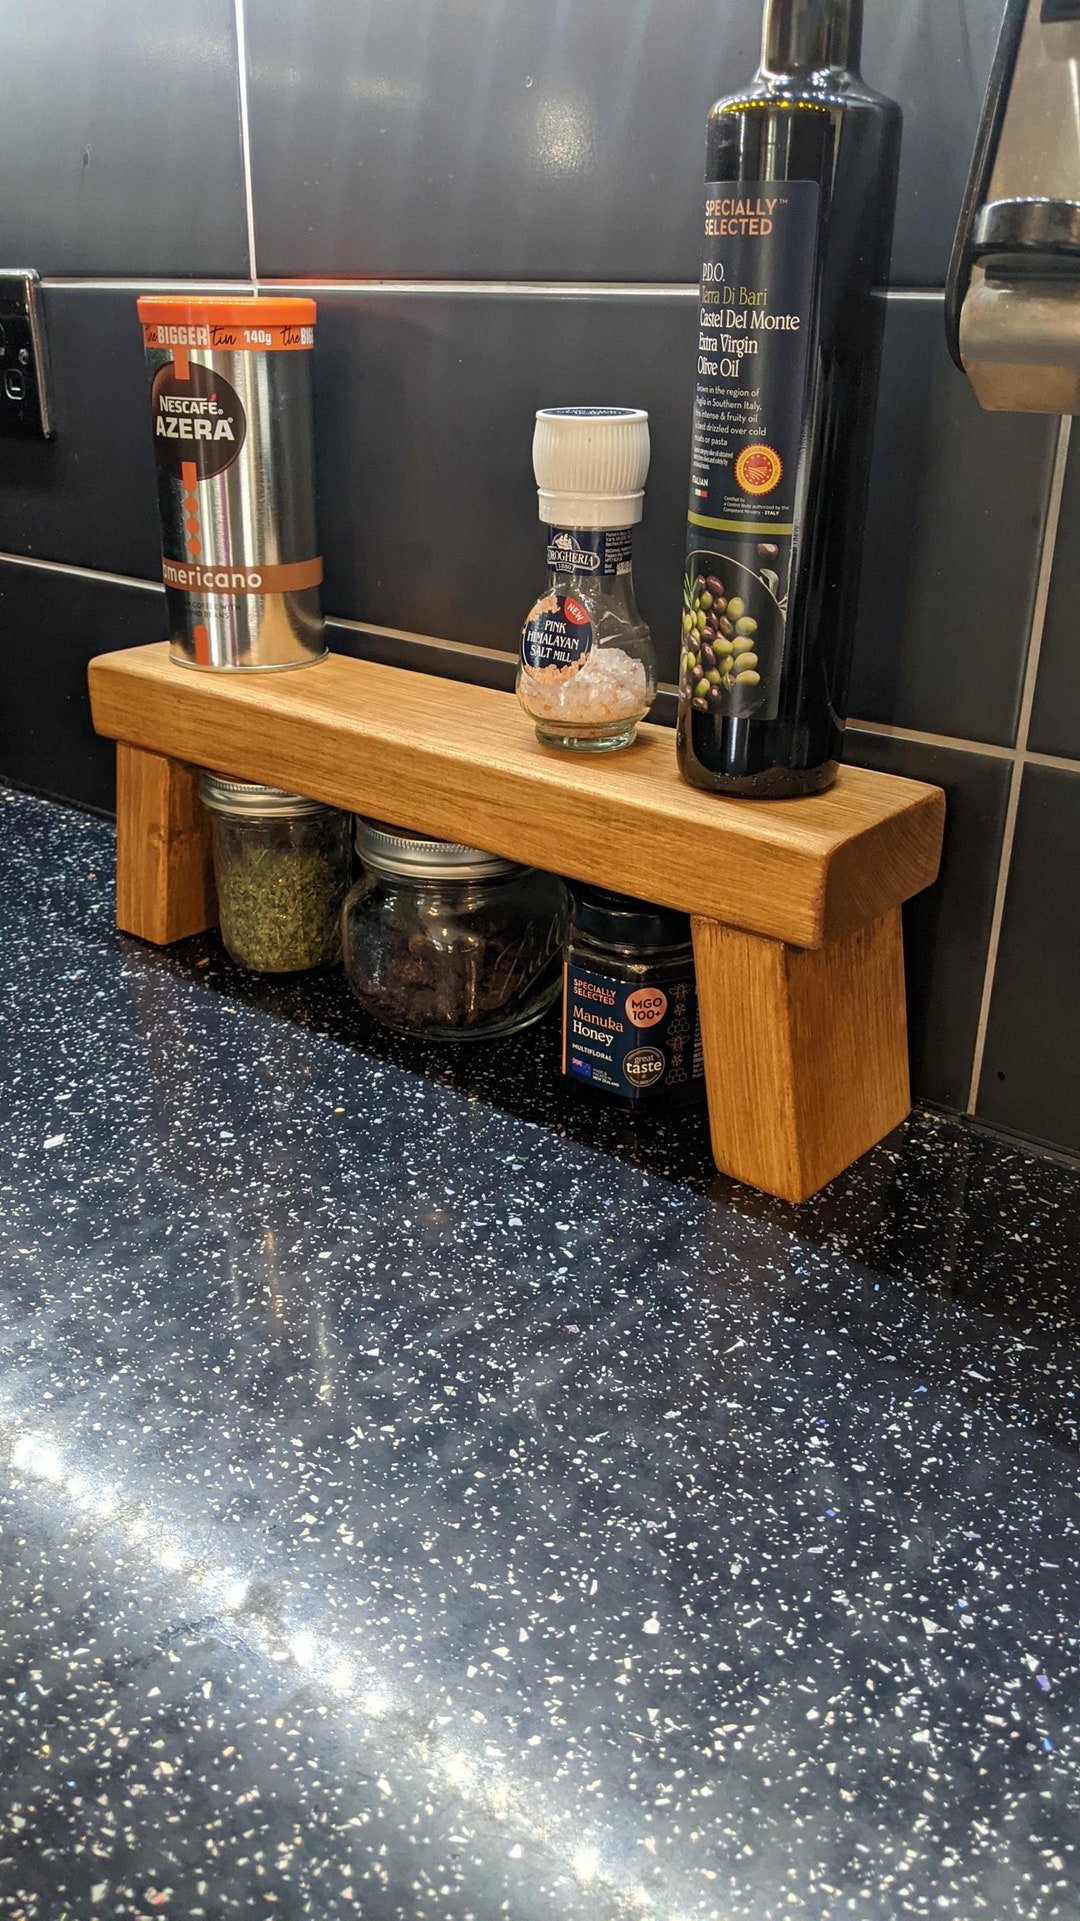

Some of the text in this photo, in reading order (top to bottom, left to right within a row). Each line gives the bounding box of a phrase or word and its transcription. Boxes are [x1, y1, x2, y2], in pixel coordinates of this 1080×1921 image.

[705, 198, 778, 216] SPECIALLY
[704, 218, 773, 236] SELECTED
[722, 286, 735, 305] Di
[738, 286, 767, 306] Bari
[699, 307, 800, 331] Castel Del Monte
[157, 325, 208, 345] BIGGER
[209, 324, 238, 346] tin
[243, 330, 272, 346] 140g
[280, 325, 301, 346] the
[699, 332, 758, 358] Extra Virgin
[697, 355, 740, 378] Olive Oil
[715, 385, 725, 395] the
[726, 388, 749, 398] region
[751, 388, 760, 397] of
[712, 398, 742, 409] Southern
[727, 412, 747, 424] fruity
[748, 414, 758, 423] oil
[156, 416, 235, 441] AZERA
[707, 422, 729, 434] drizzled
[748, 427, 767, 436] cold
[711, 438, 727, 446] pasta
[221, 604, 241, 612] WITH
[566, 602, 585, 621] NEW
[544, 620, 567, 634] PINK
[526, 631, 580, 650] HIMALAYAN
[529, 645, 572, 663] SALT MILL
[573, 978, 617, 998] SPECIALLY
[573, 986, 616, 1006] SELECTED
[631, 997, 663, 1010] MGO
[572, 1005, 624, 1033] Manuka
[632, 1009, 662, 1021] 100+
[572, 1019, 614, 1047] Honey
[572, 1042, 613, 1062] MULTIFLORAL
[634, 1054, 655, 1065] great
[626, 1060, 662, 1074] taste
